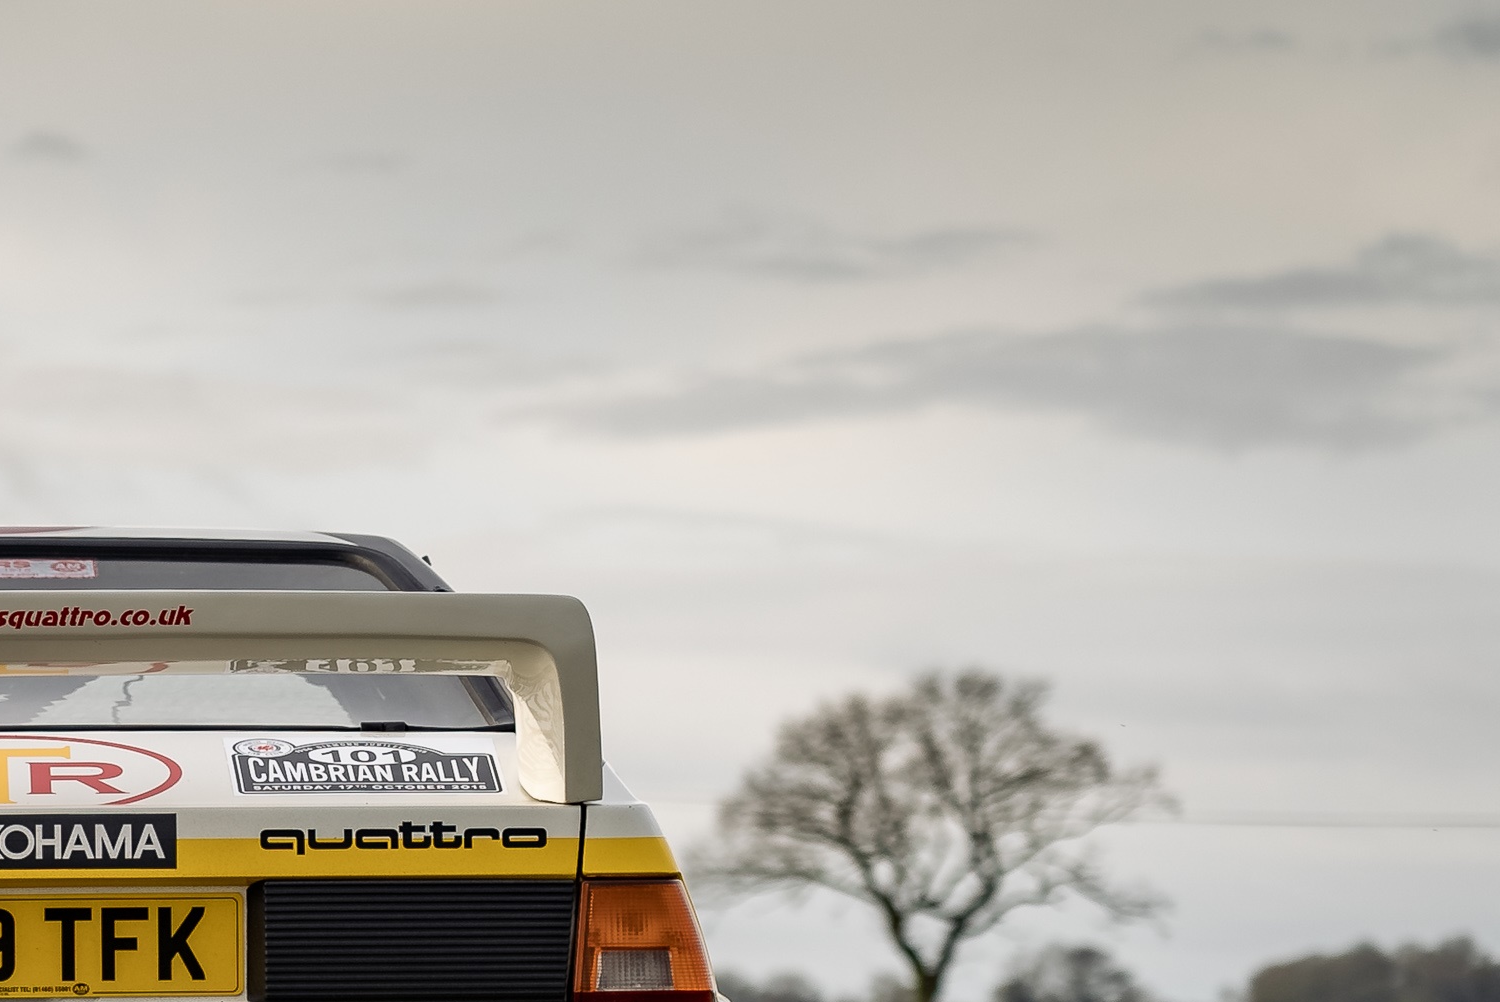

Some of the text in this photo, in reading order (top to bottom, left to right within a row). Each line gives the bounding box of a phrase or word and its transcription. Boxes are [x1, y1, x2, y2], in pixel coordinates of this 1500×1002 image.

[249, 755, 479, 783] CAMBRIAN RALLY
[319, 749, 402, 763] 101
[259, 821, 548, 855] quattro
[44, 906, 207, 982] TFK
